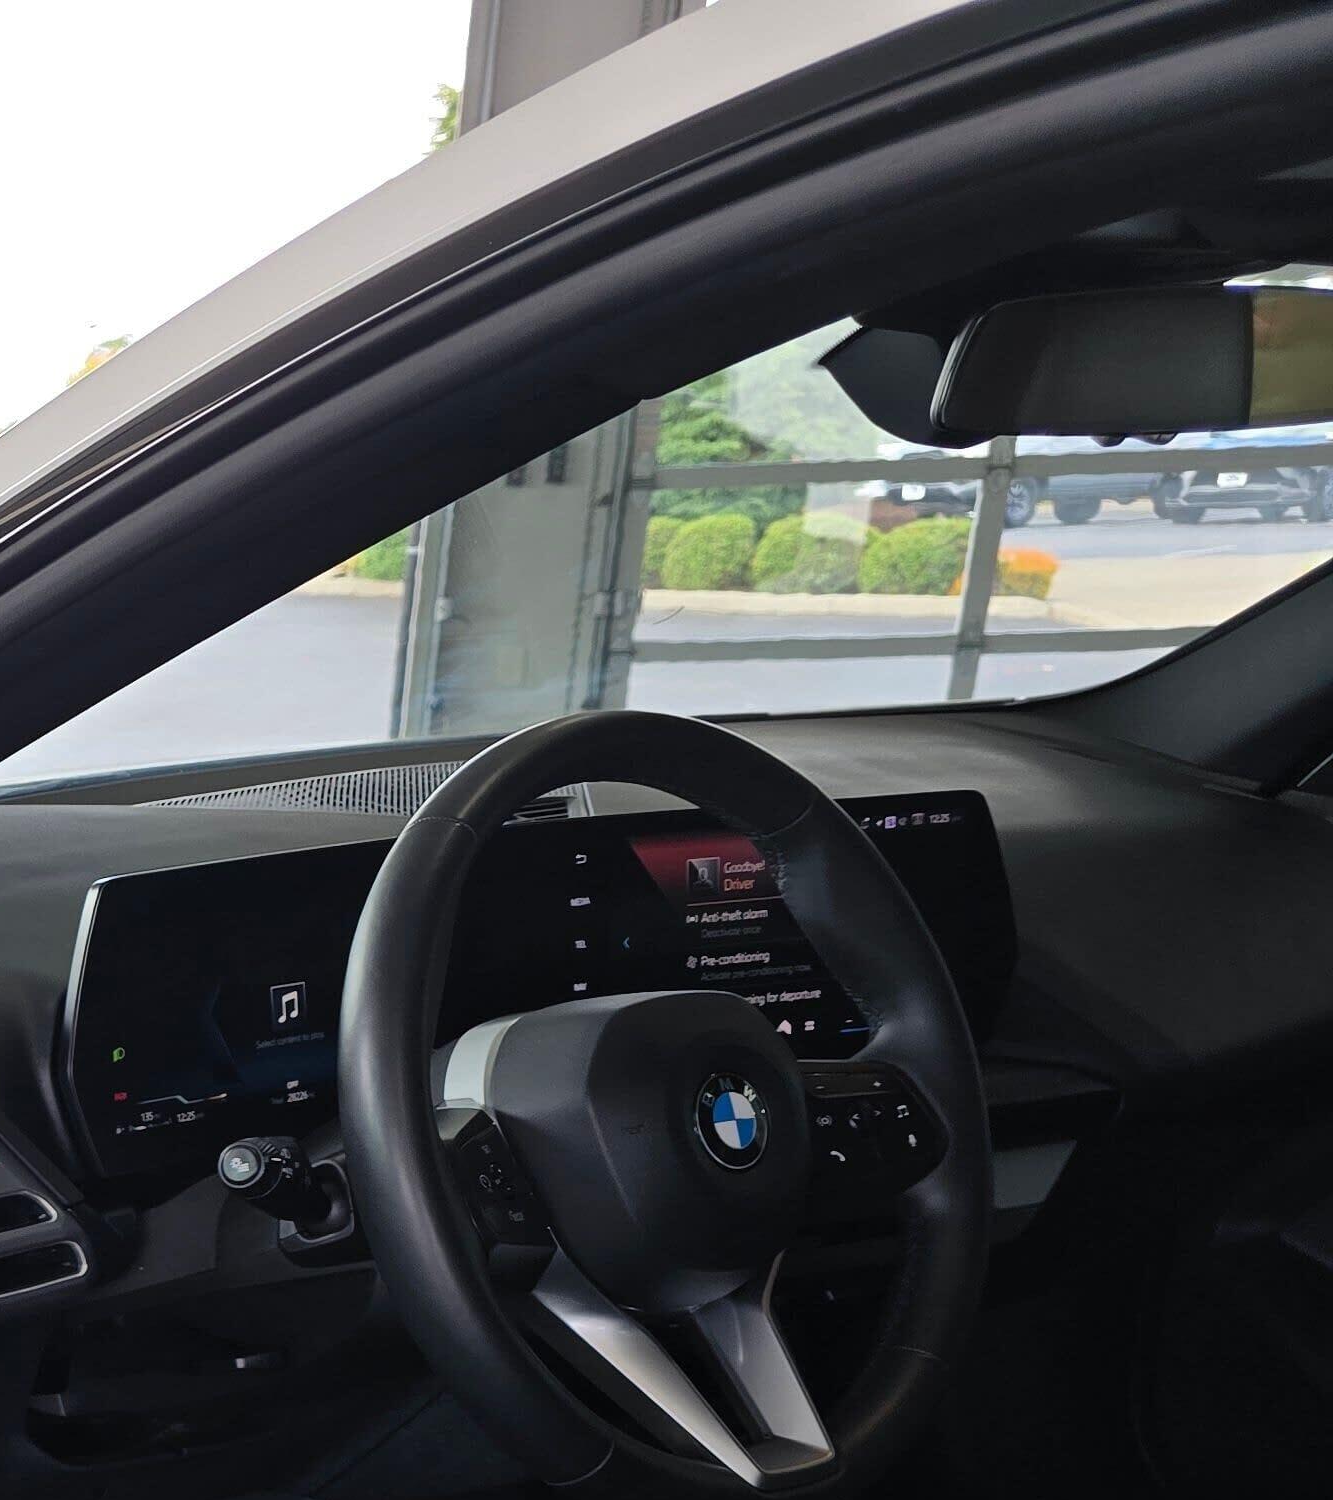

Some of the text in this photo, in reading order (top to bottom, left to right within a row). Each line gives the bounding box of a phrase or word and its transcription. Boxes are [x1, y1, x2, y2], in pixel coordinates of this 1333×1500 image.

[724, 860, 766, 874] Goodbye!
[724, 878, 756, 892] Driver
[700, 908, 769, 923] Anti-theft alarm
[700, 951, 771, 967] Pre-conditioning
[780, 989, 822, 1002] departure
